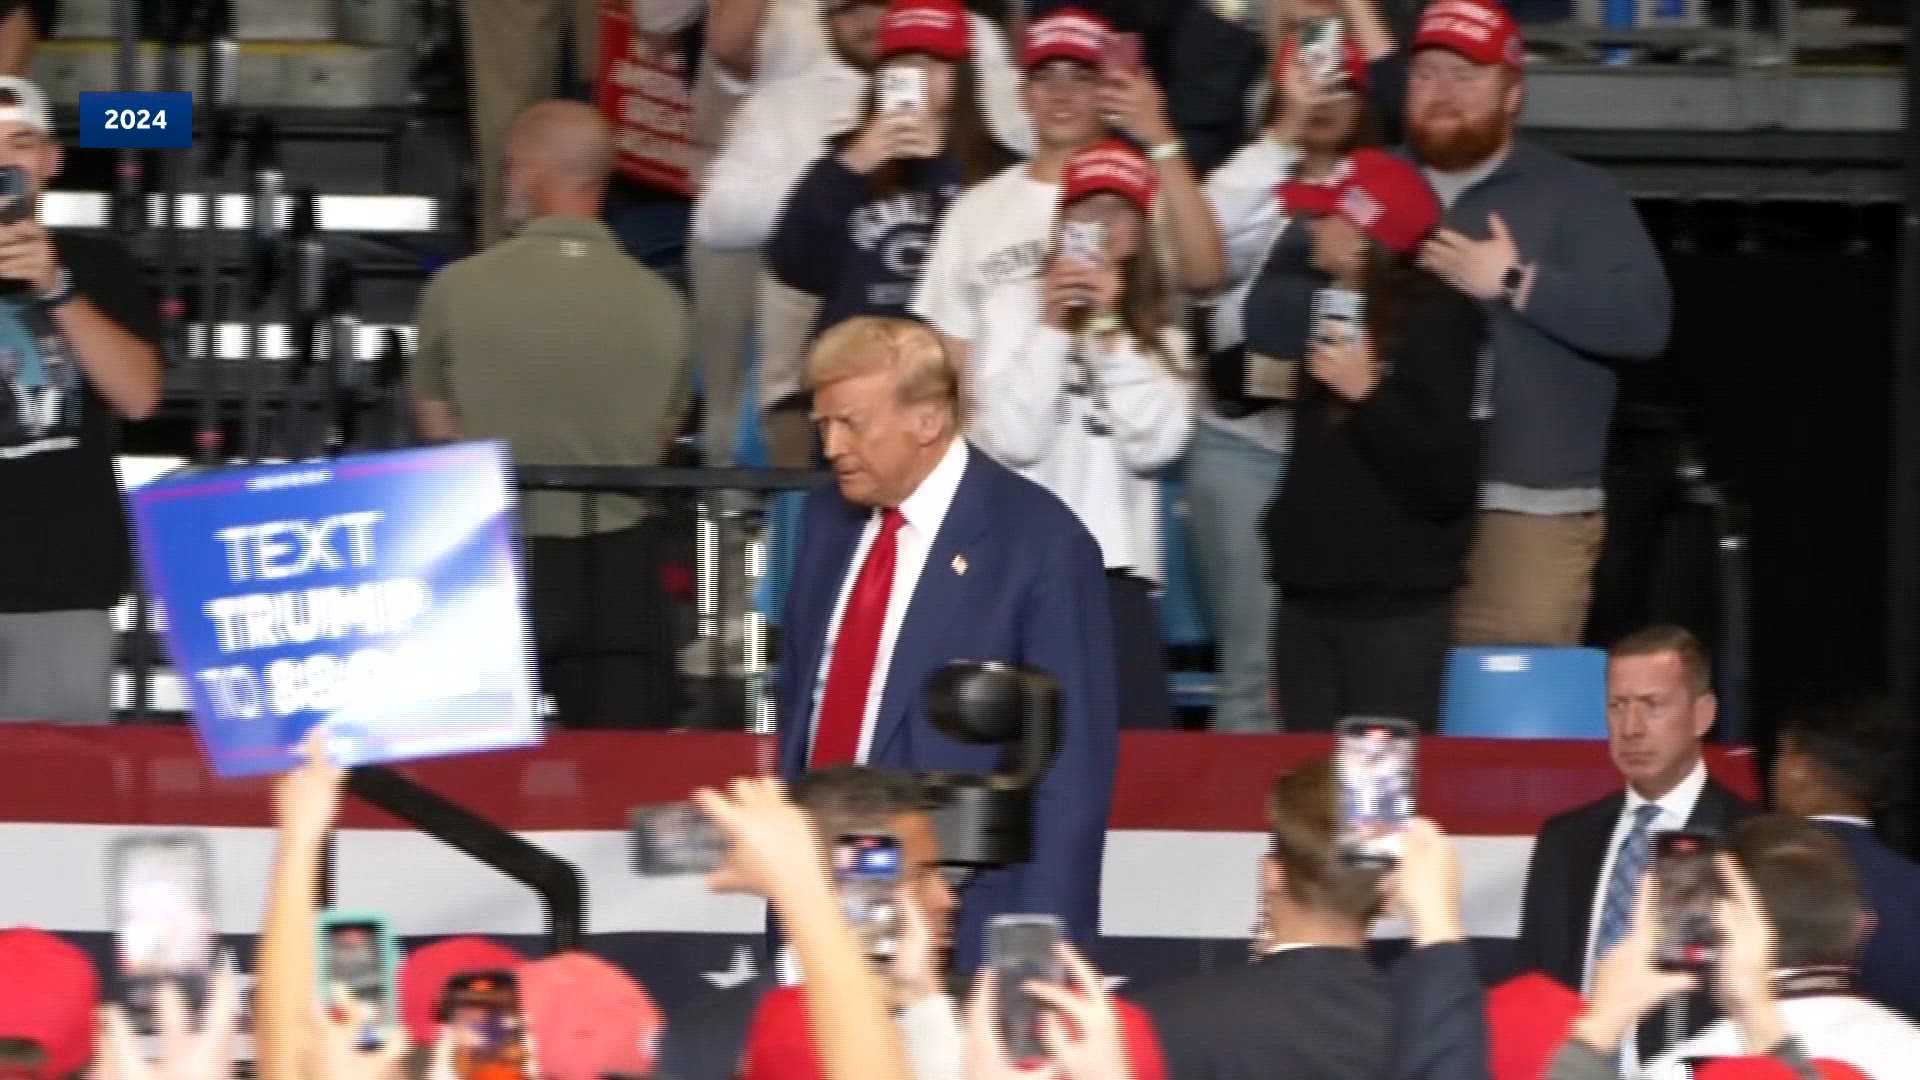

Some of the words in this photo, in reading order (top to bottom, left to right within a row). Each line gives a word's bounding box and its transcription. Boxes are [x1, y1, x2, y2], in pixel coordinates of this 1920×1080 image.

[213, 510, 384, 582] TEXT
[203, 577, 431, 653] TRUMP
[198, 664, 262, 719] TO
